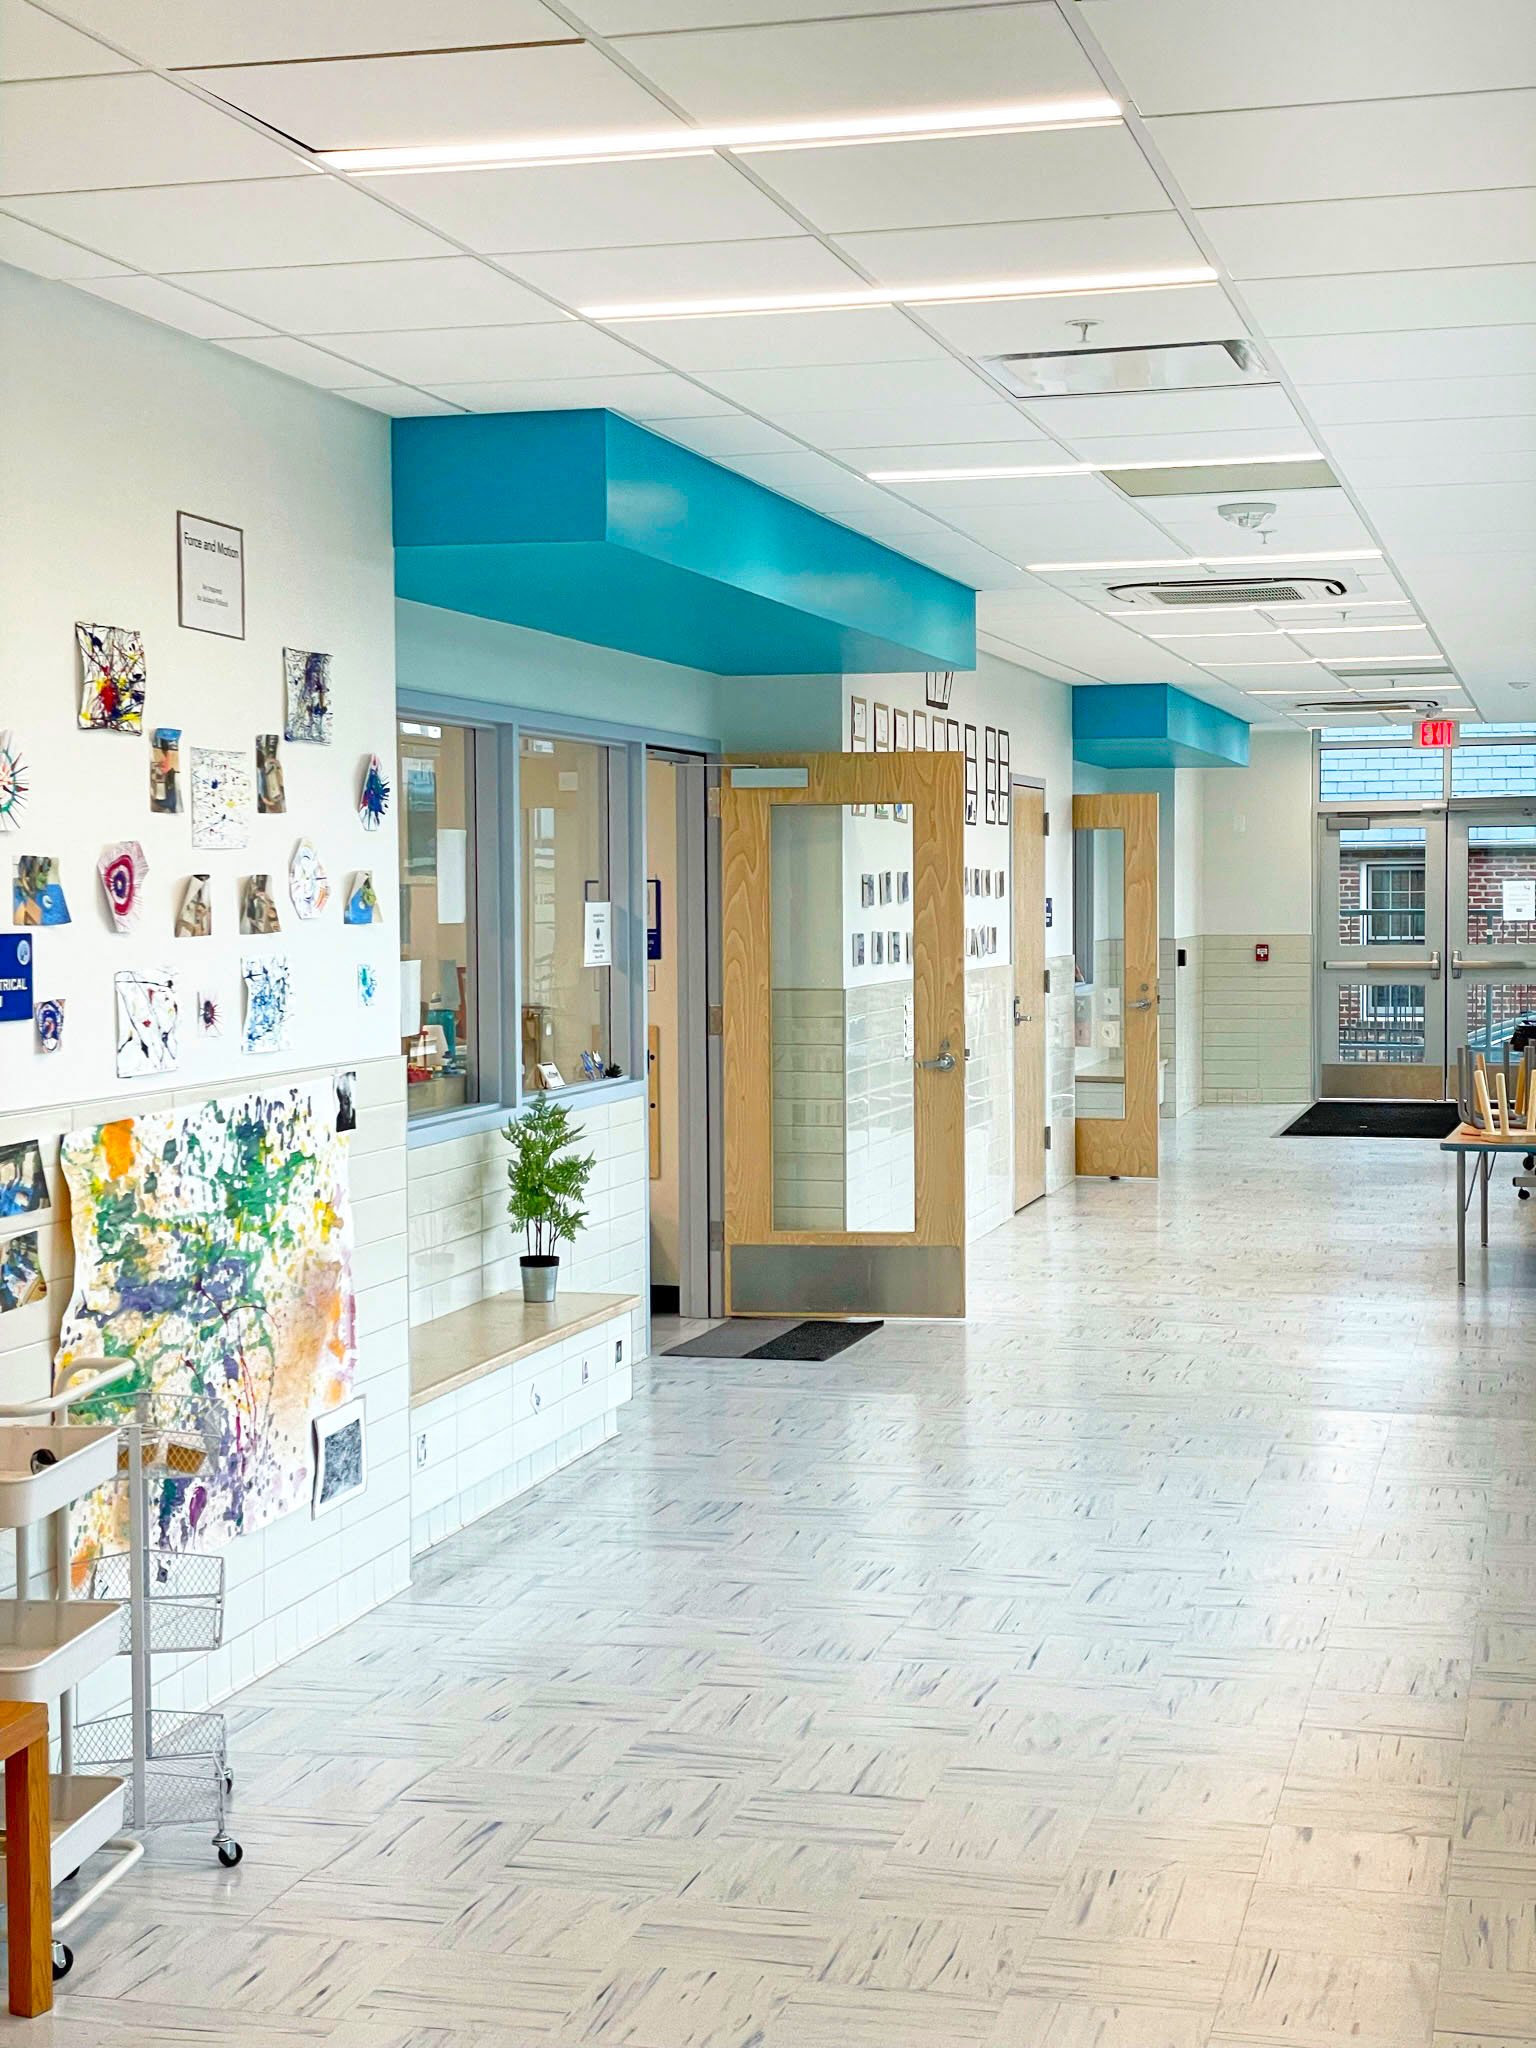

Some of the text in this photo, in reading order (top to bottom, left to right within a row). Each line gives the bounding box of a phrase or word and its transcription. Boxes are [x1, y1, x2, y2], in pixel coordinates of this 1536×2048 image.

[184, 531, 239, 559] Force and Motion
[1421, 721, 1453, 746] EXIT
